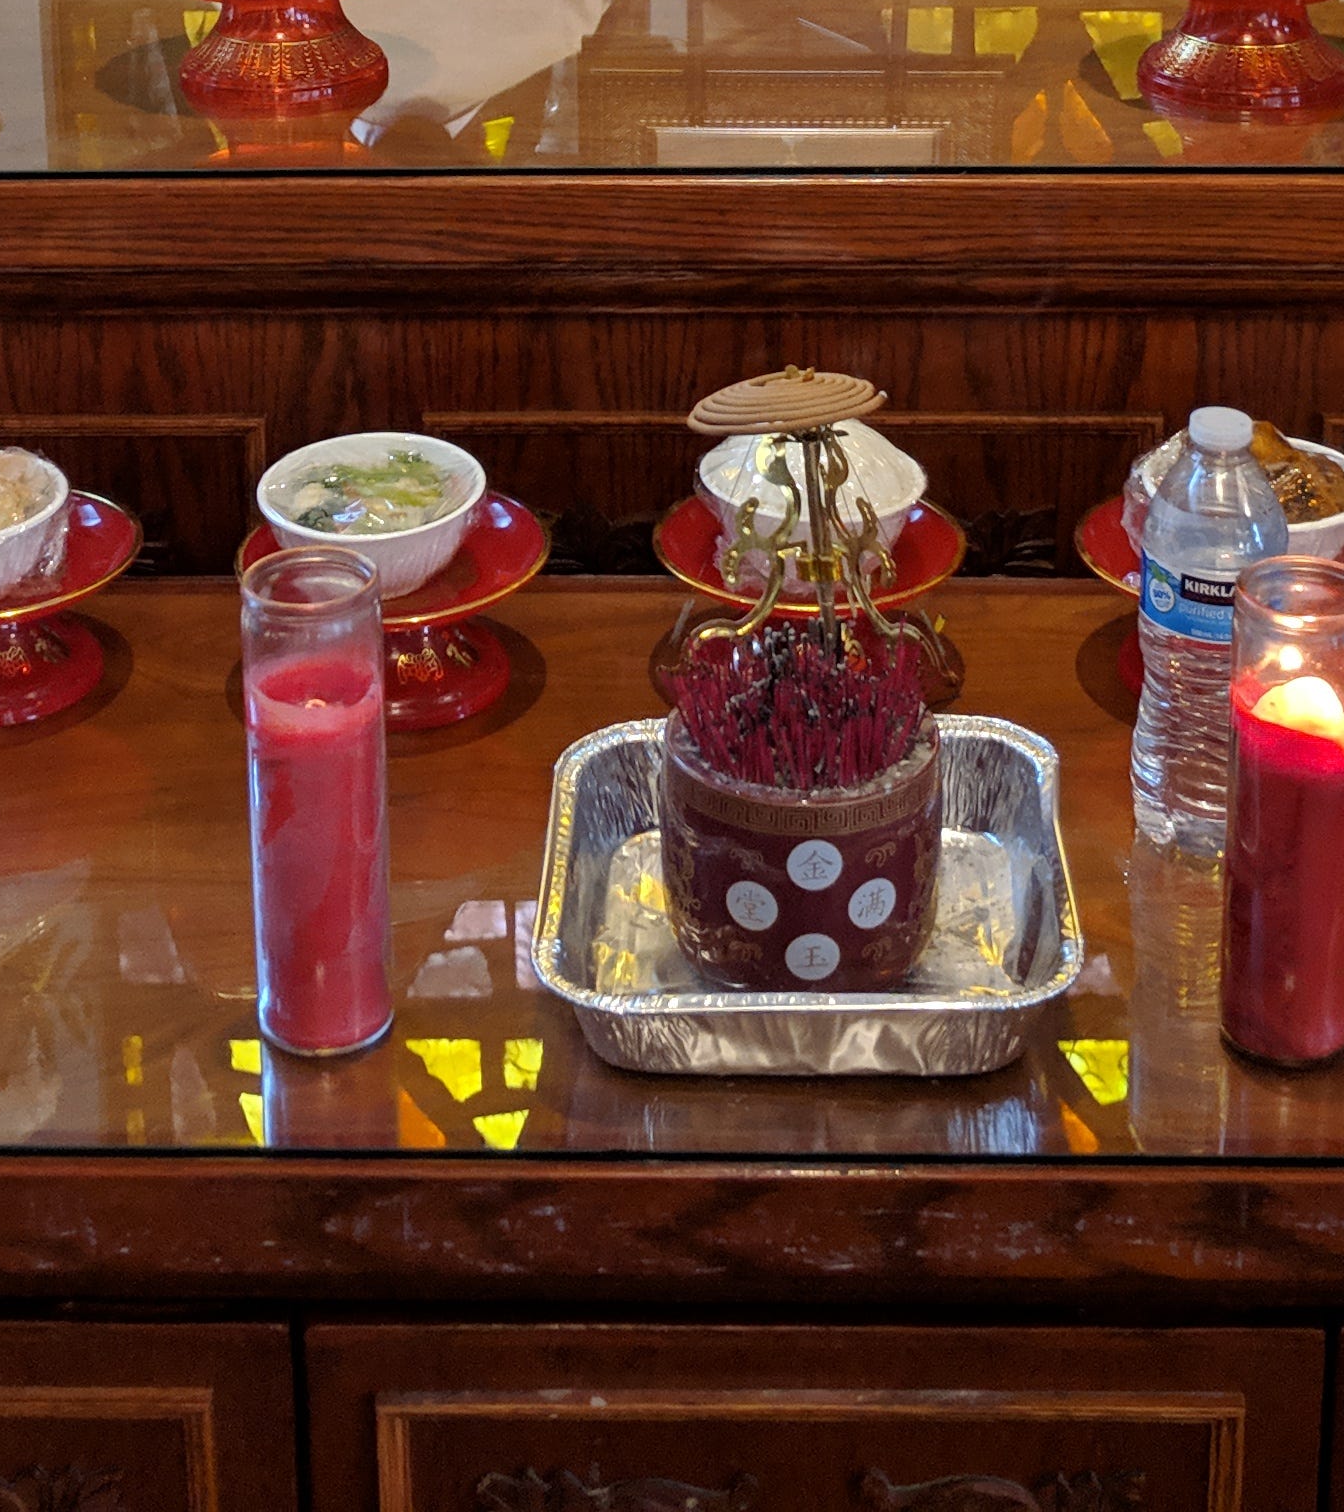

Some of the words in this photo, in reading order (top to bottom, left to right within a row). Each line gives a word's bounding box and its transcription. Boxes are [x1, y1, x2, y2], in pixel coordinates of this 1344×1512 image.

[797, 849, 834, 881] 金
[736, 889, 766, 923] 堂
[798, 944, 829, 968] 玉
